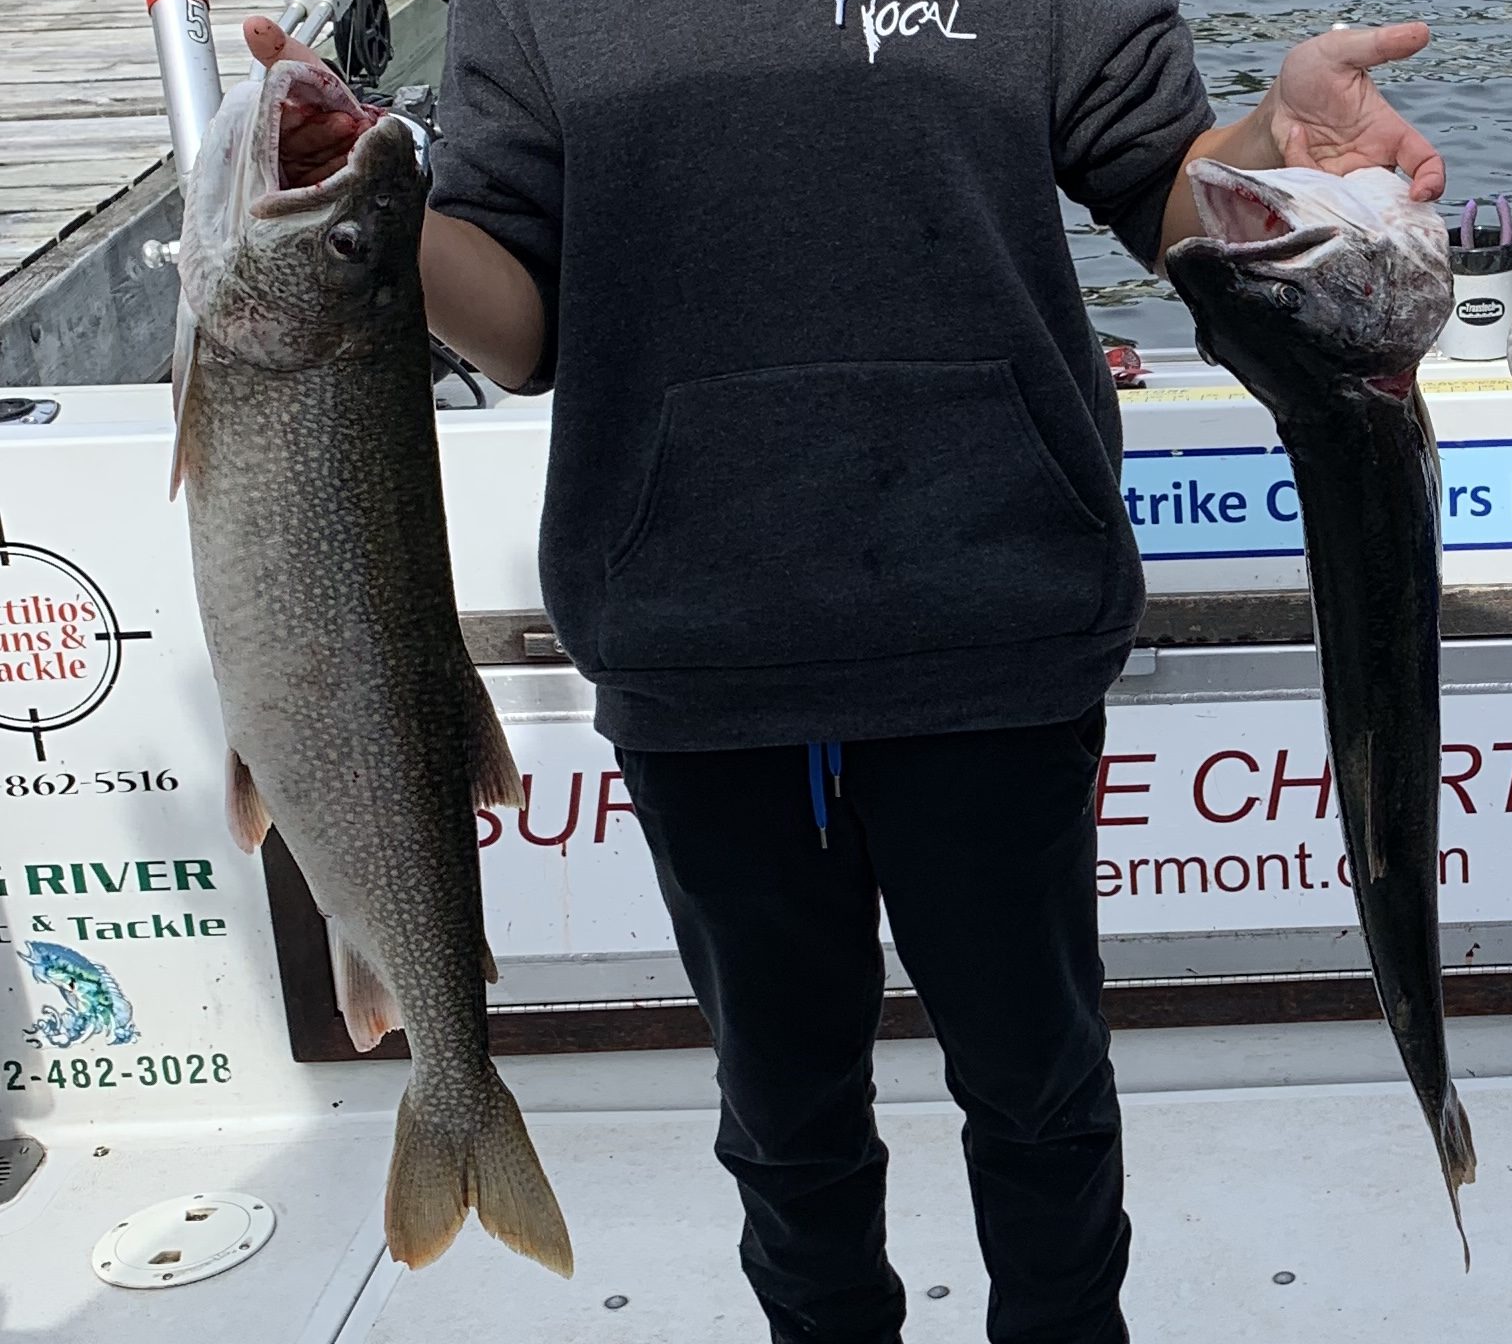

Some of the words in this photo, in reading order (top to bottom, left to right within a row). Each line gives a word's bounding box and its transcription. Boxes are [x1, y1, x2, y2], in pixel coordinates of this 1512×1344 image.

[1123, 479, 1247, 524] trike
[0, 594, 96, 625] tilio's
[61, 624, 87, 649] &
[0, 652, 87, 682] ackle
[0, 768, 179, 797] 862-5516
[24, 859, 217, 895] RIVER
[32, 915, 56, 932] &
[67, 913, 228, 941] Tackle
